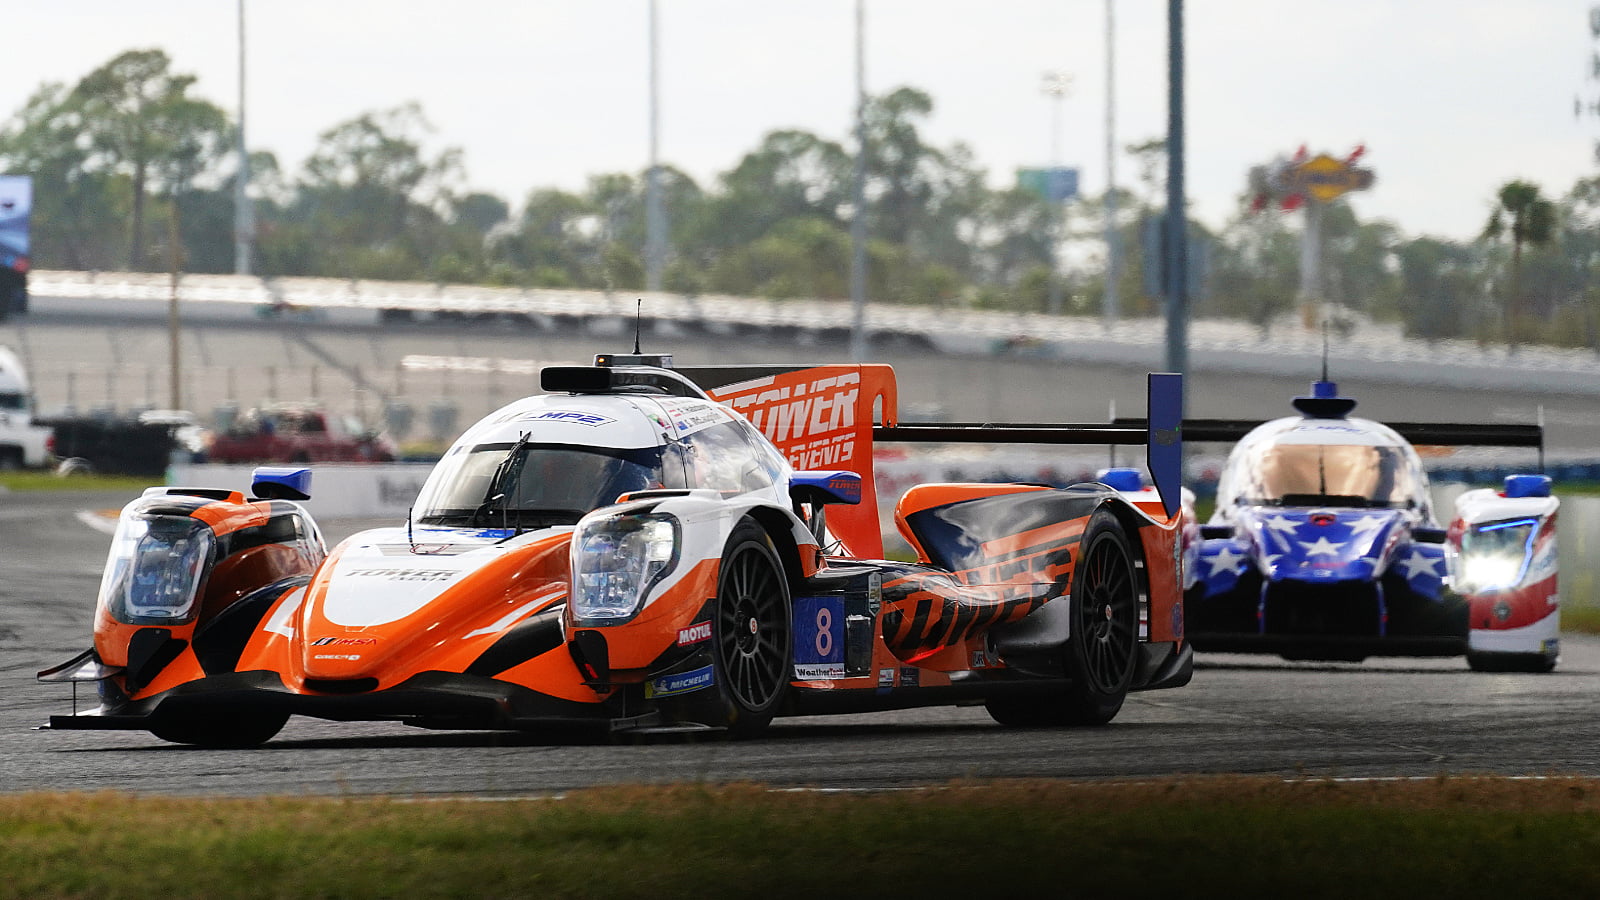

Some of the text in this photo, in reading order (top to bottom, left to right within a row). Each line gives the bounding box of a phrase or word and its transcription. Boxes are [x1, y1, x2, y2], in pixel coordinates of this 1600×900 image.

[679, 623, 712, 644] MOTUL
[751, 620, 757, 633] 8
[816, 608, 832, 656] 8
[333, 638, 377, 646] IMSA
[797, 667, 844, 677] WeatherTech
[669, 673, 711, 690] MICHELIN
